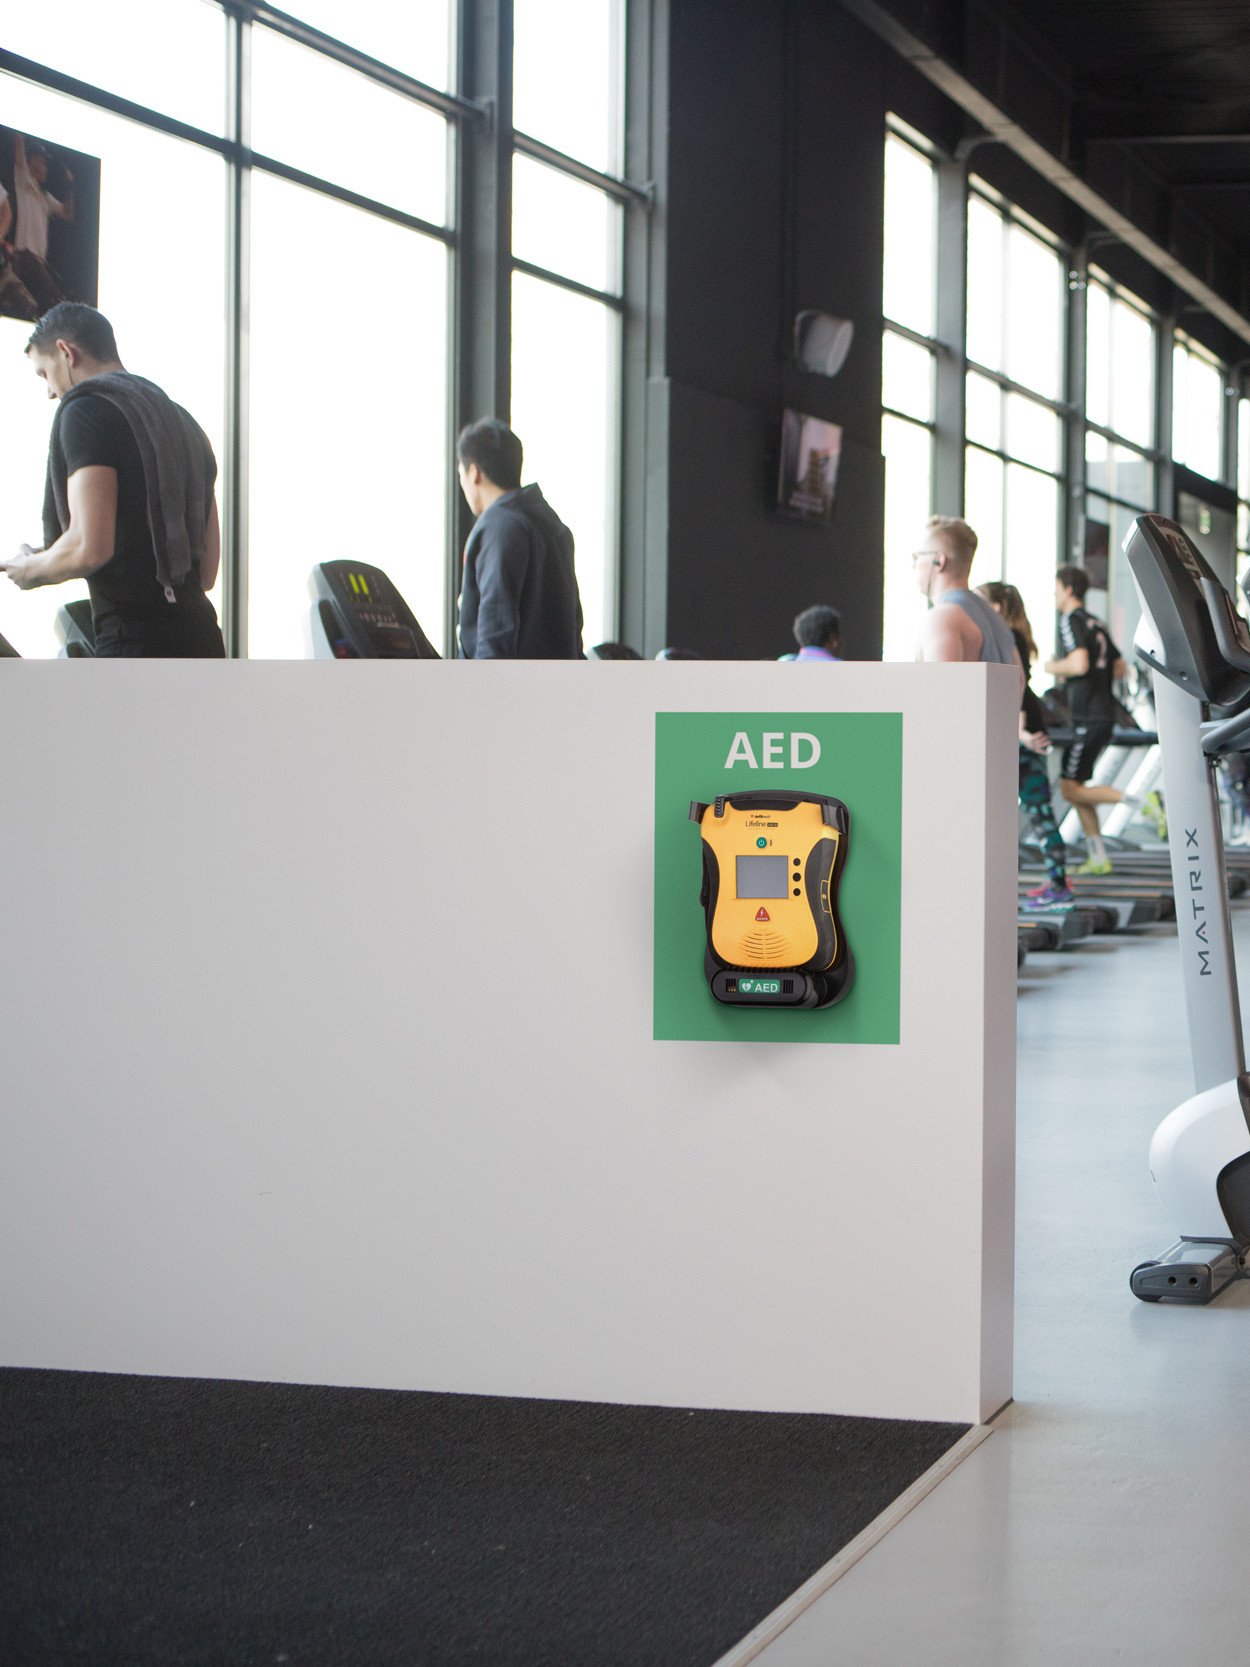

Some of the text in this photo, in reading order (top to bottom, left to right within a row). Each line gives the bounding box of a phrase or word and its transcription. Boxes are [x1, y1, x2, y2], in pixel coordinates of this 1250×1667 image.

[724, 731, 822, 769] AED
[1184, 827, 1212, 976] MATRIX
[754, 983, 778, 993] AED
